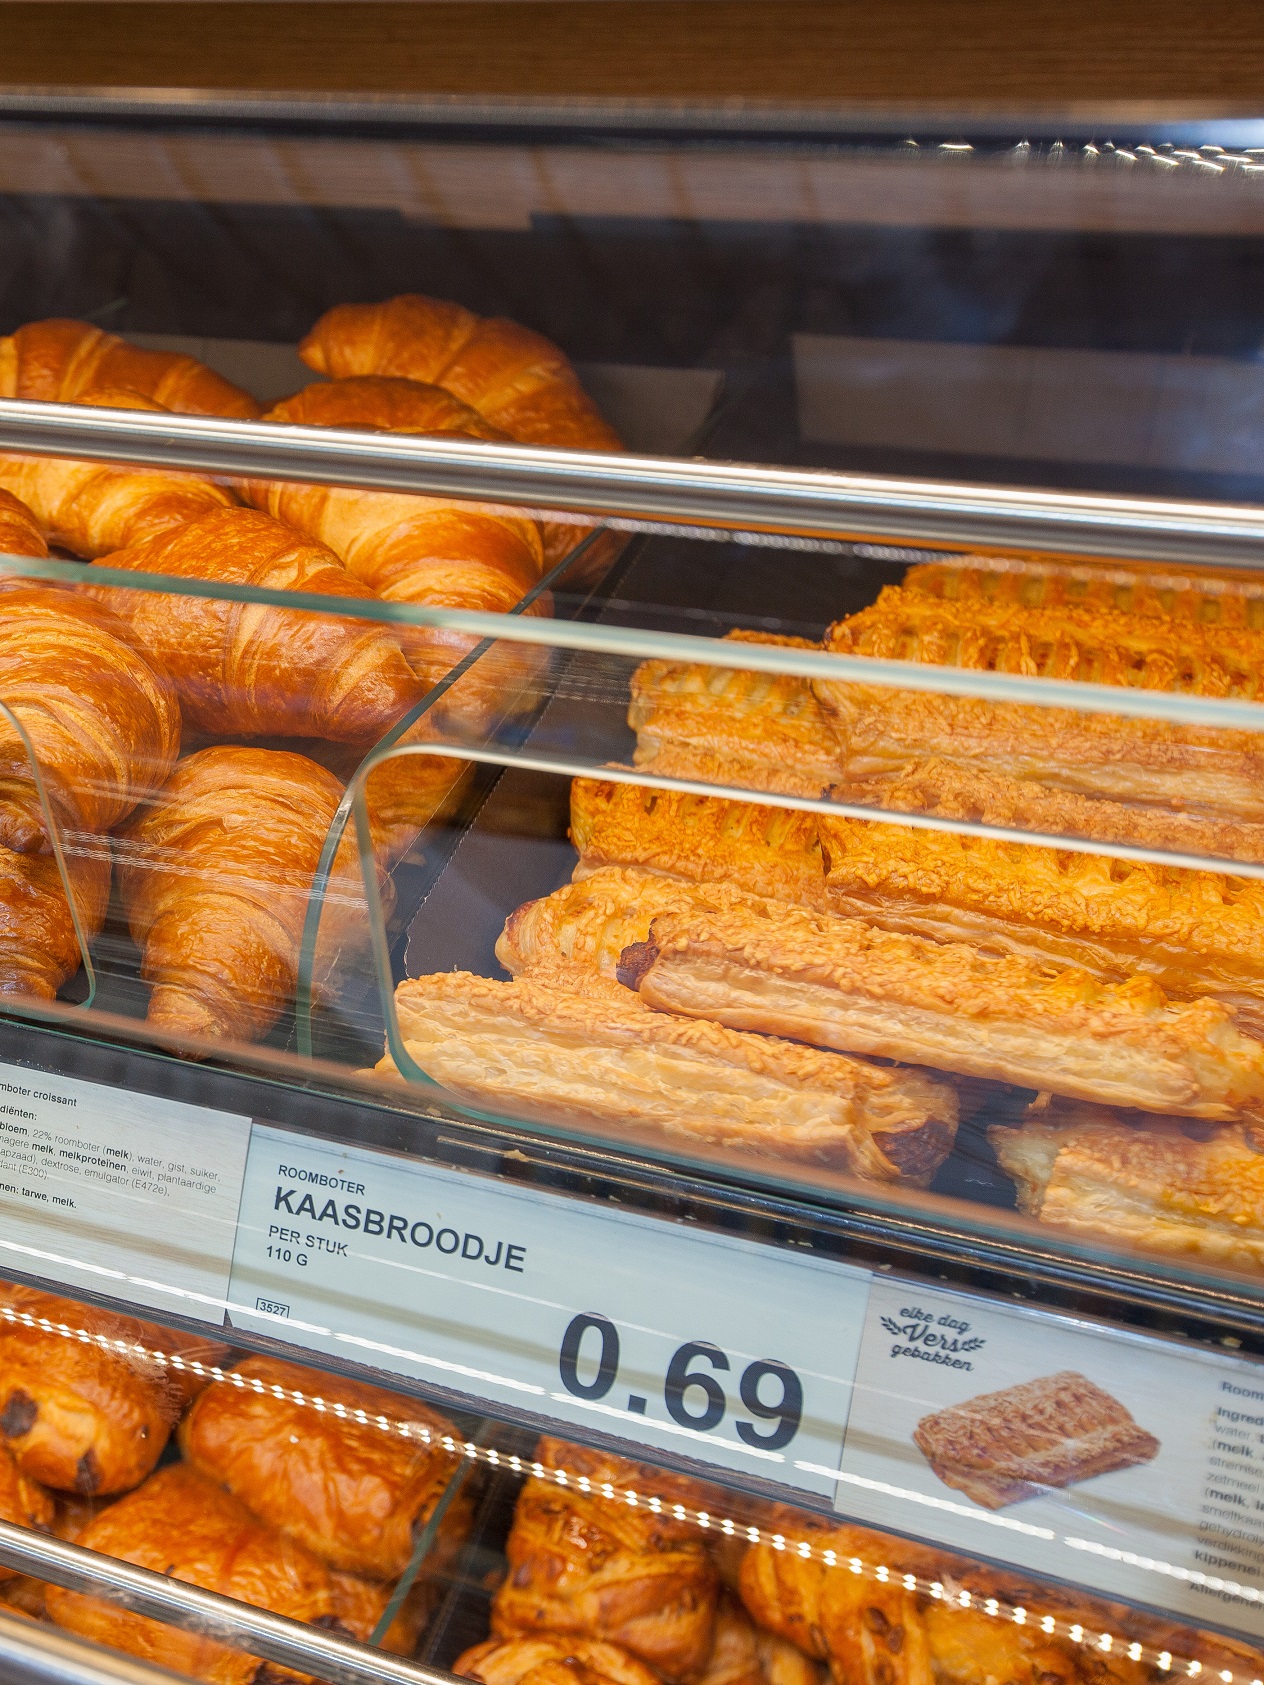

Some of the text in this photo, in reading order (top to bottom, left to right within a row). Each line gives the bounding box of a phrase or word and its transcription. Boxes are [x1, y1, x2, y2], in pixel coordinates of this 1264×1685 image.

[33, 1090, 77, 1107] croissant
[32, 1129, 52, 1142] 22%
[54, 1135, 100, 1152] roomboter
[137, 1155, 165, 1169] water,
[167, 1162, 187, 1175] gist,
[31, 1142, 56, 1156] melk,
[59, 1149, 129, 1174] melkproteïnen,
[157, 1172, 217, 1195] plantaardige
[41, 1157, 82, 1175] dextrose,
[84, 1168, 129, 1186] emulgator
[278, 1164, 366, 1195] ROOMBOTER
[22, 1187, 49, 1203] tarwe,
[52, 1195, 77, 1209] melk.
[268, 1225, 349, 1257] PER STUK
[274, 1186, 527, 1273] KAASBROODJE
[266, 1245, 308, 1267] 110 G
[259, 1301, 286, 1316] 3527
[900, 1307, 971, 1336] elke dag
[902, 1324, 962, 1352] Vers
[891, 1345, 974, 1371] gebakken
[560, 1312, 803, 1450] 0.69
[1222, 1381, 1264, 1401] Room
